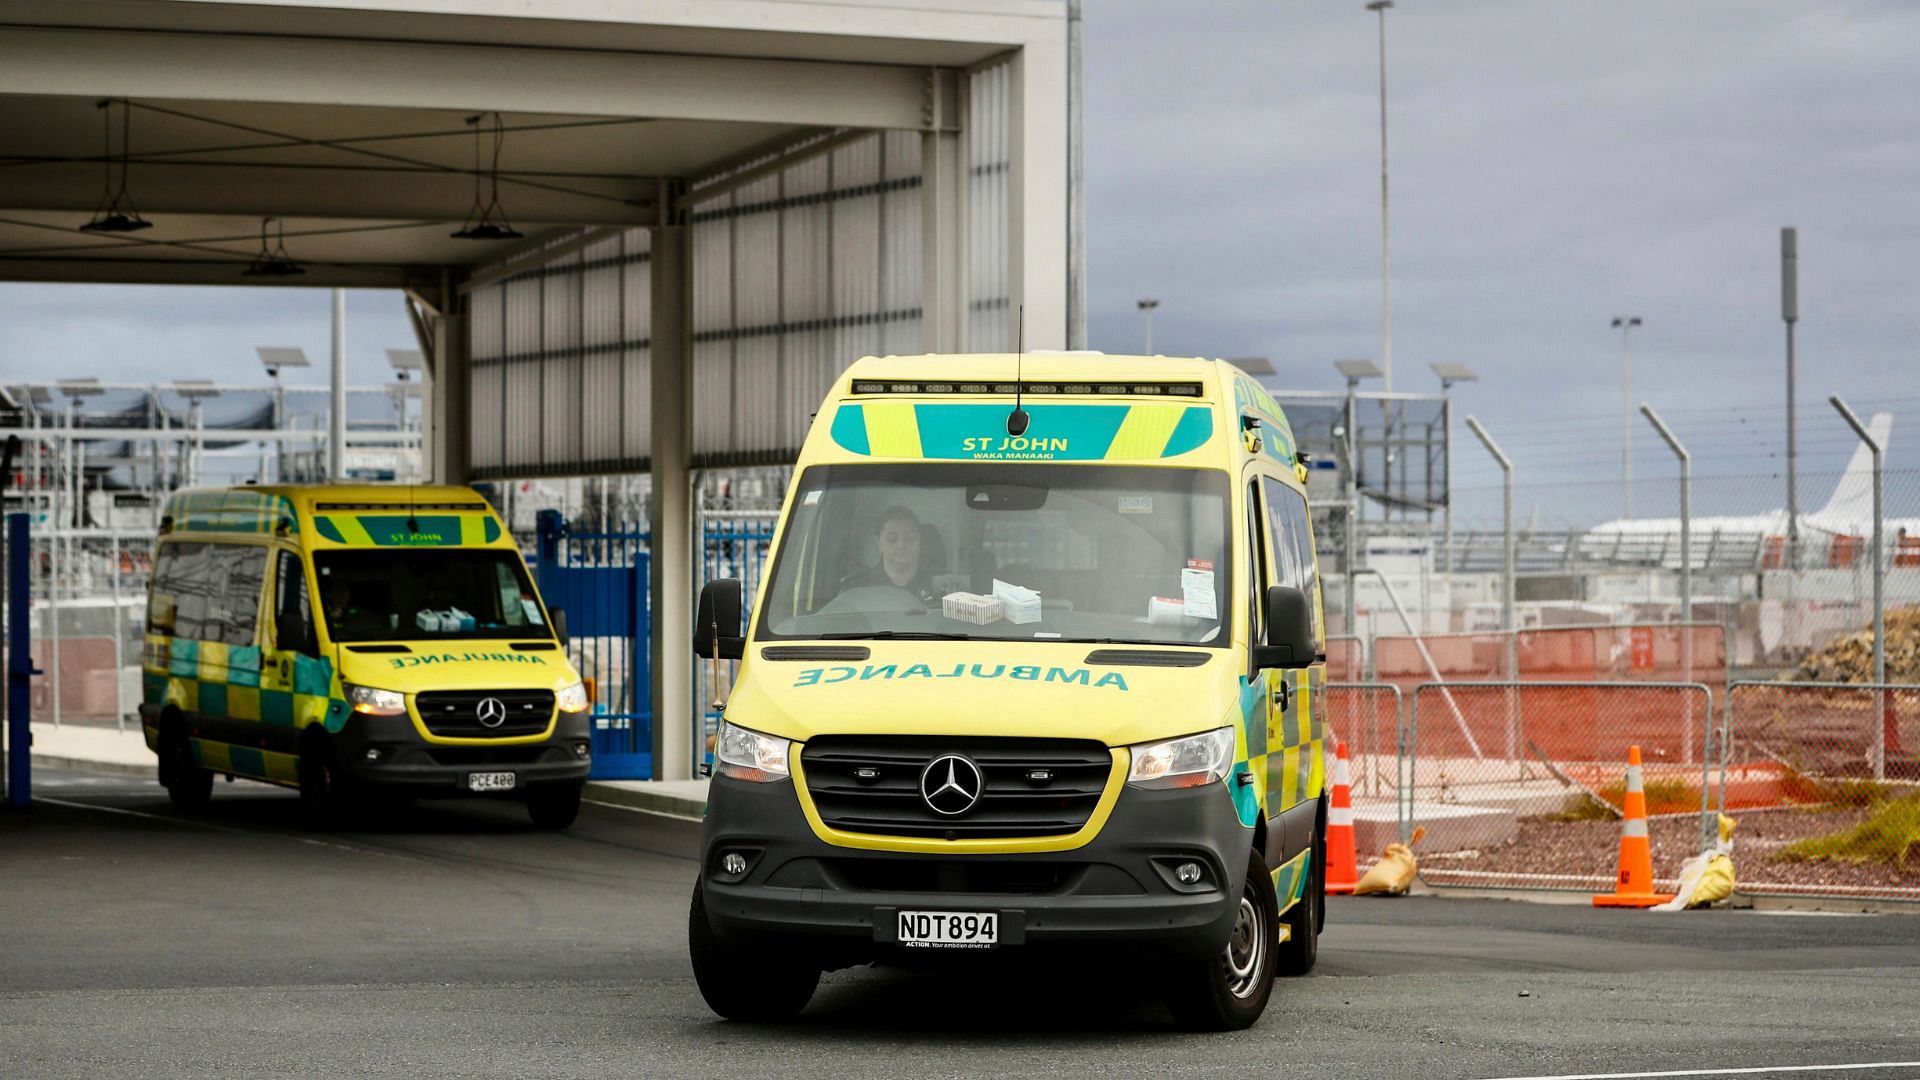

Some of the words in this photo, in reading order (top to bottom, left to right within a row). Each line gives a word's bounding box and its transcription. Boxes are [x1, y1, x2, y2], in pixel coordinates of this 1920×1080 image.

[962, 437, 993, 451] ST
[997, 437, 1068, 452] JOHN
[1005, 452, 1054, 460] MANAAKI
[901, 914, 994, 940] NDT894
